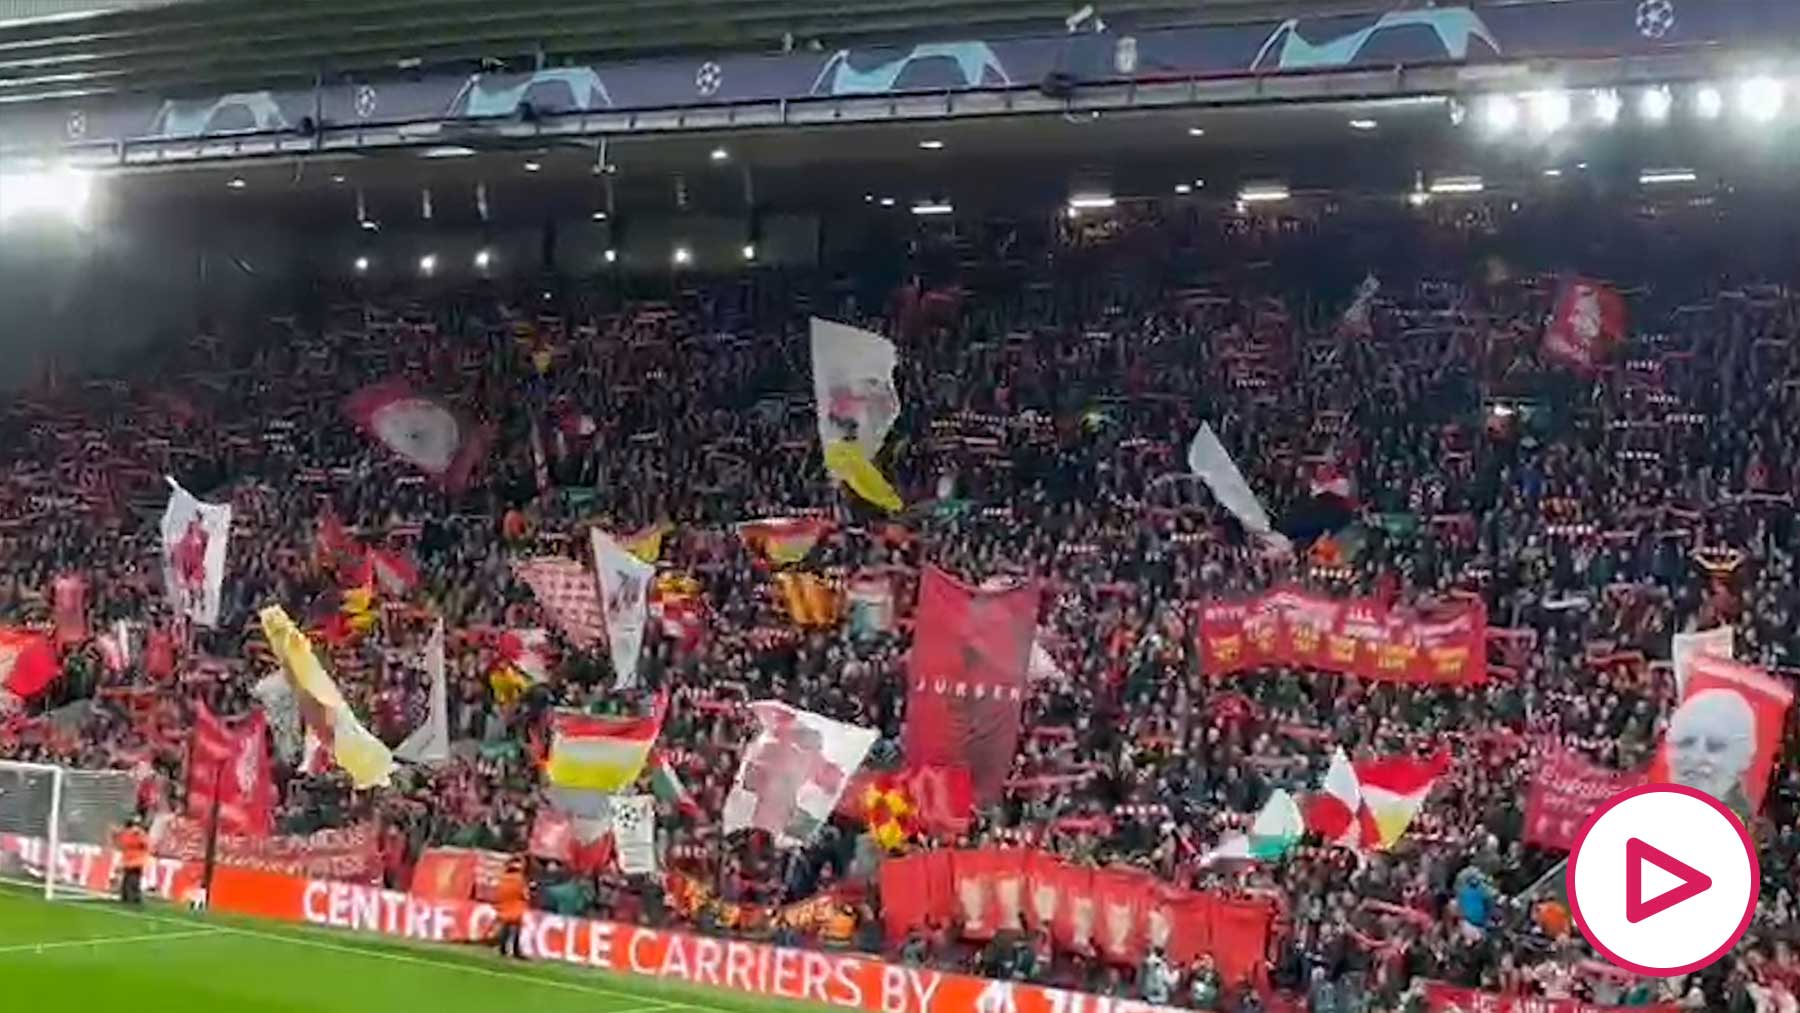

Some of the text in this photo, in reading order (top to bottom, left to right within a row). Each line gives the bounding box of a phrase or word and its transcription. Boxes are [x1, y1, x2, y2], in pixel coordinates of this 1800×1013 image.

[469, 903, 611, 967] CRCLE
[628, 928, 862, 1007] CARRIERS
[881, 965, 942, 1013] BY
